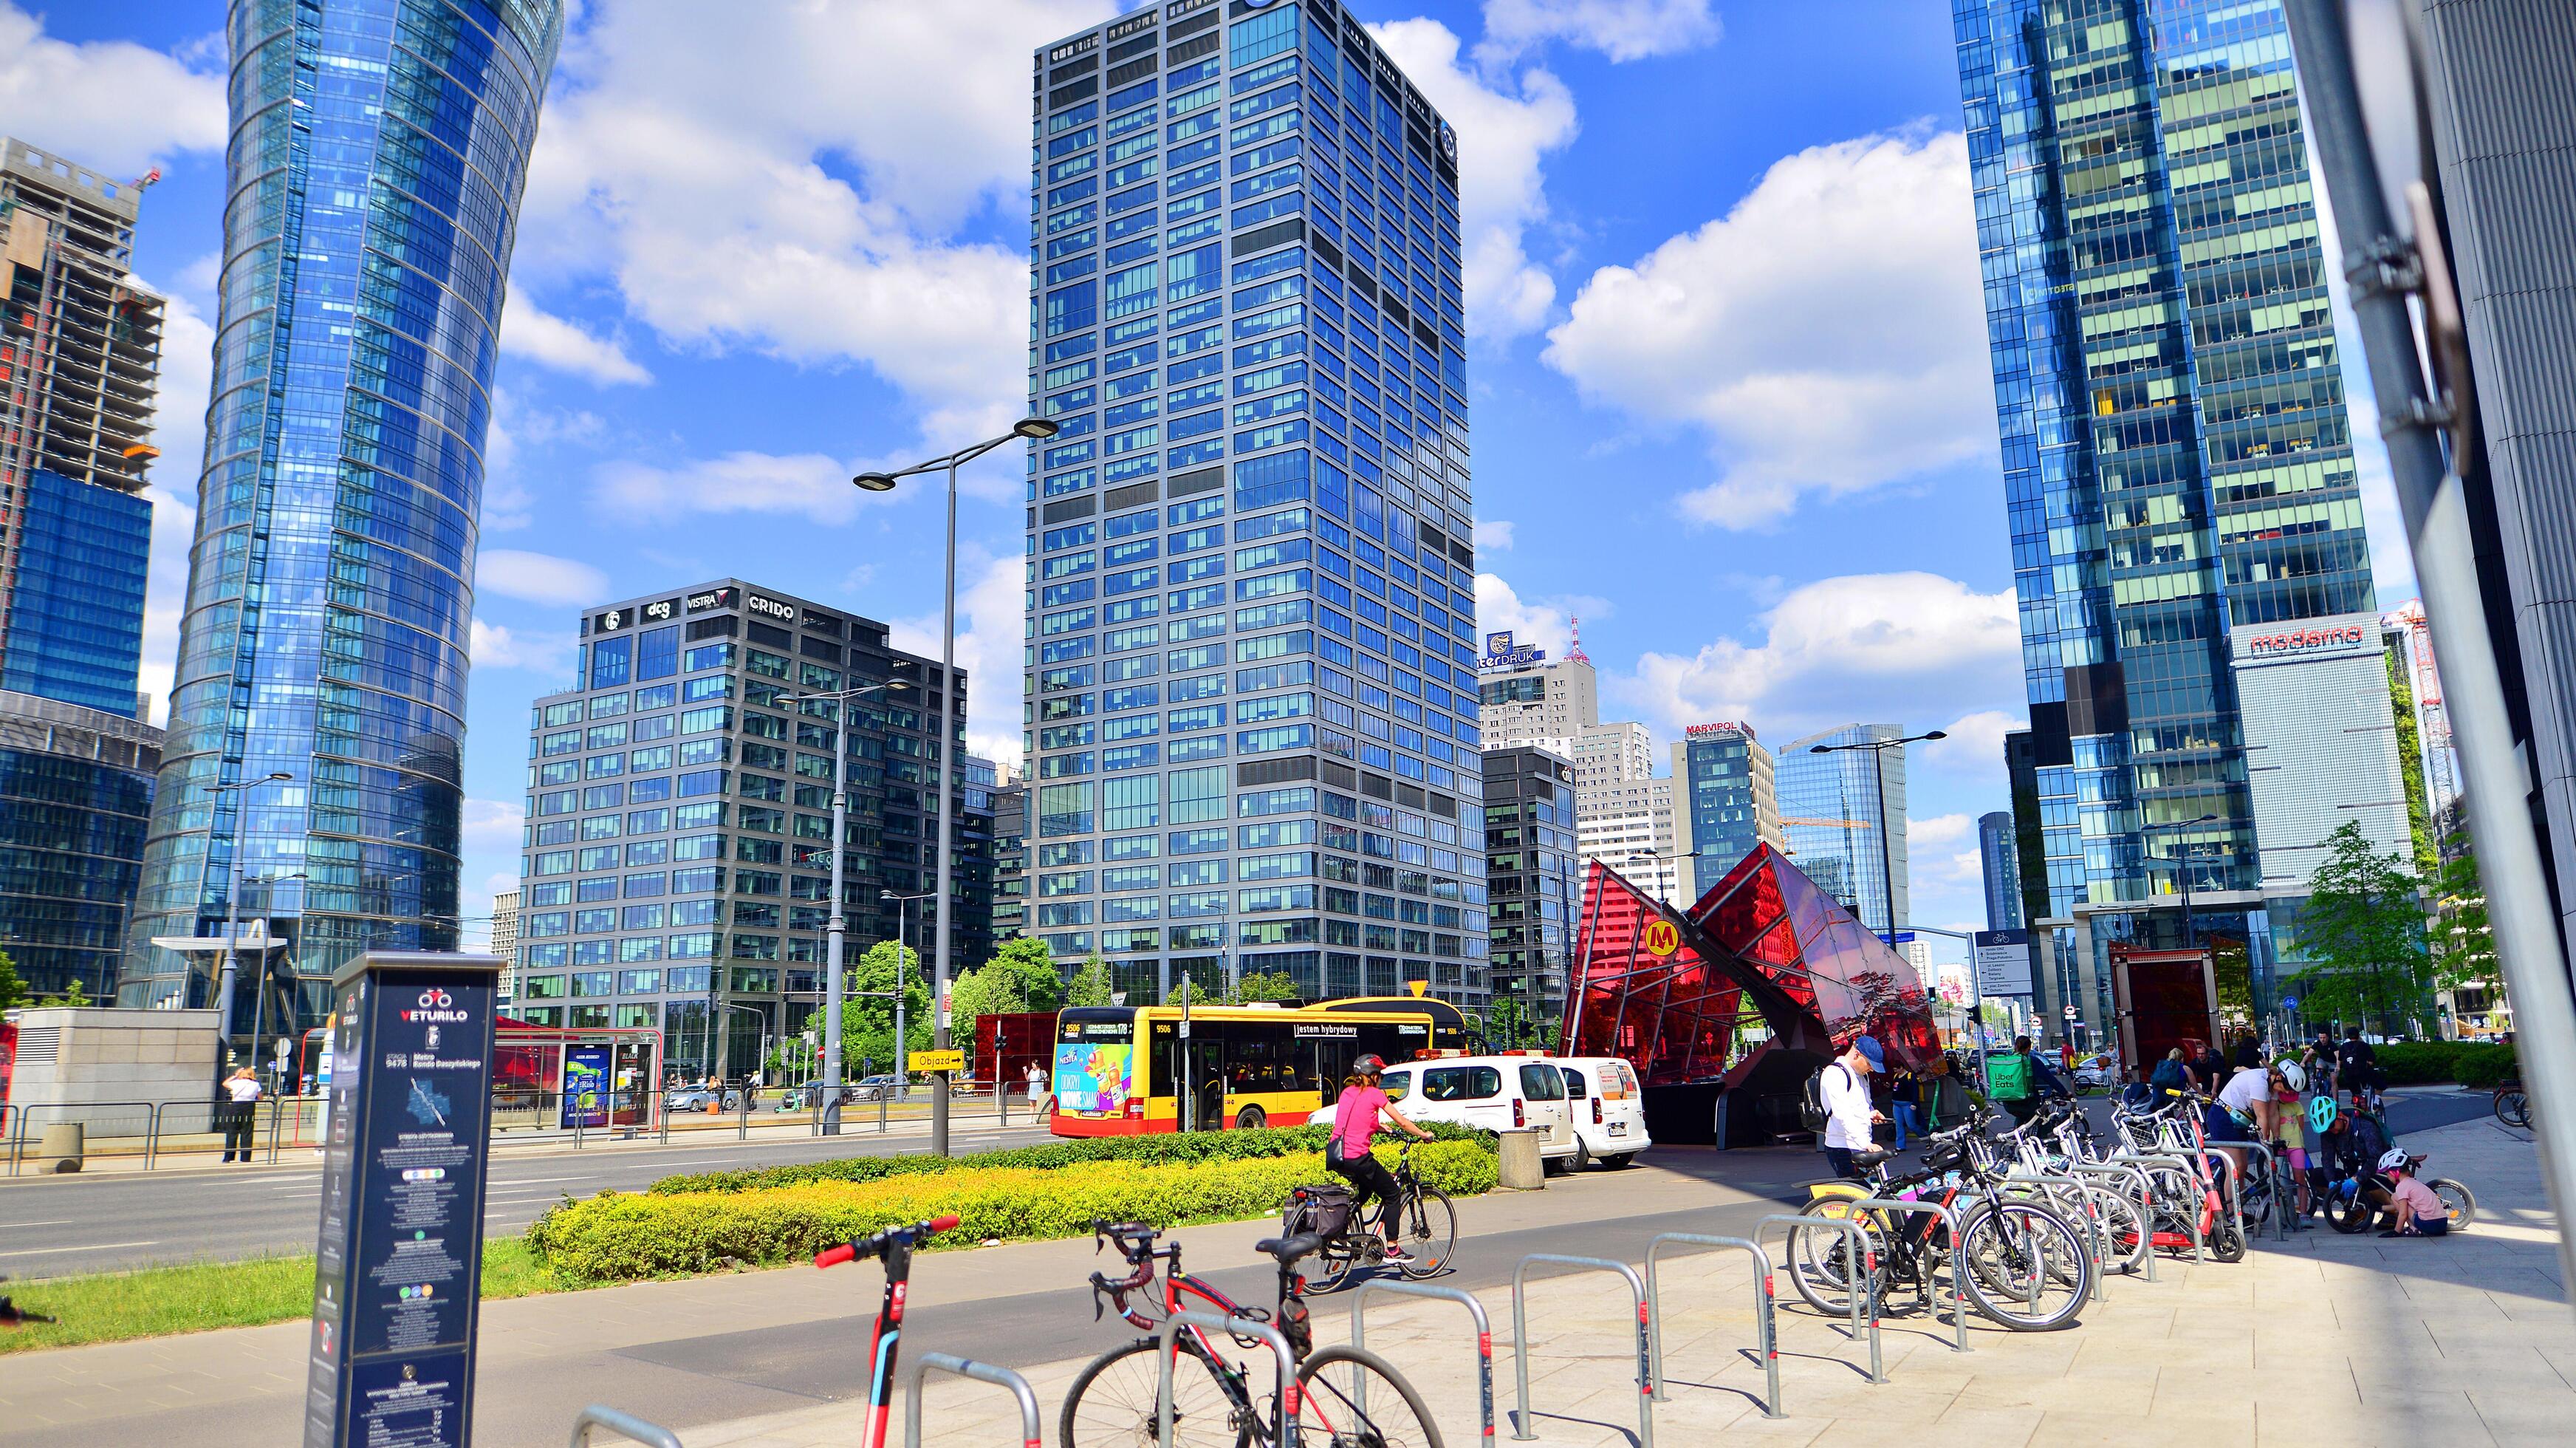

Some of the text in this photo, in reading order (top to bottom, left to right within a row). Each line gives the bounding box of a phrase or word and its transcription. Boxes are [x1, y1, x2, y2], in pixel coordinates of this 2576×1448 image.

[688, 594, 716, 609] VISTRA
[749, 596, 794, 619] CRIDO
[648, 602, 671, 619] dcg
[606, 611, 620, 631] f5
[2251, 626, 2363, 650] moderna
[1686, 722, 1737, 734] MARVIPOL
[400, 1010, 468, 1022] VETURILO
[1066, 1024, 1080, 1032] 9506
[1117, 1024, 1128, 1035] 178
[1157, 1025, 1171, 1033] 9506
[1296, 1025, 1357, 1036] jestem hybrydowy
[919, 1054, 950, 1068] Objazd
[1059, 1055, 1078, 1065] NESTEA
[1061, 1074, 1080, 1090] ODKRYJ
[1061, 1090, 1100, 1109] NOWE SMAKI
